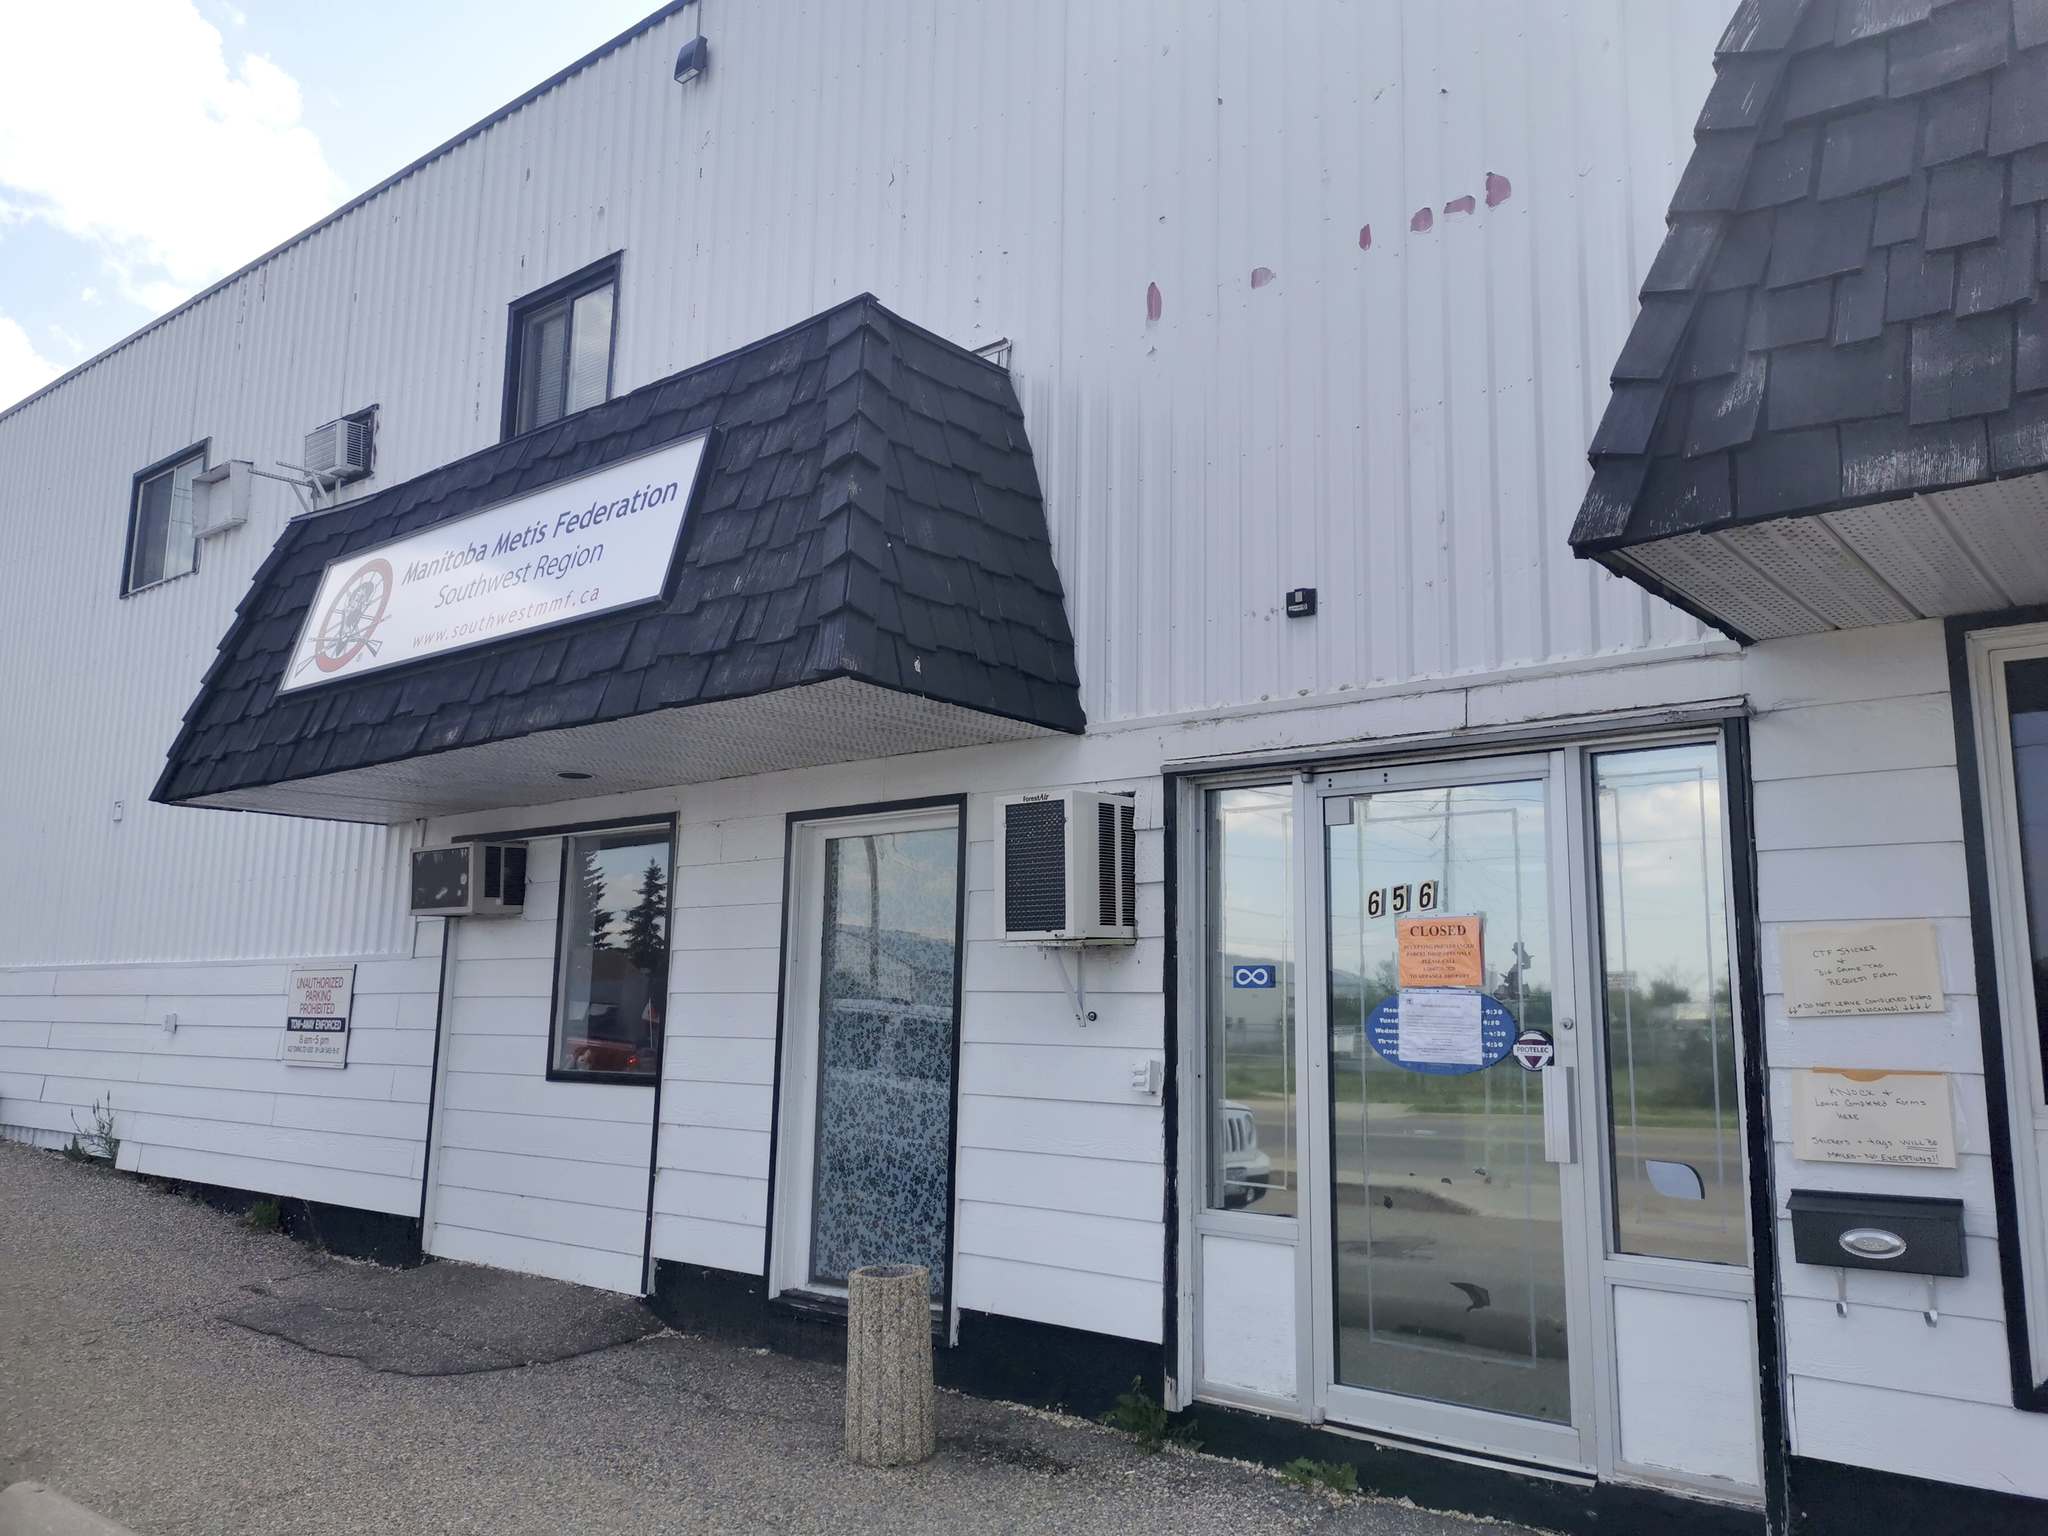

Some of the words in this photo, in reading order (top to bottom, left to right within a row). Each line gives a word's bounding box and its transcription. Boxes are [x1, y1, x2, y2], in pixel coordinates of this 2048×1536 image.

[401, 542, 488, 586] Manitoba
[491, 520, 549, 559] Metis
[553, 482, 679, 538] Federation
[434, 562, 532, 609] Southwest
[533, 543, 604, 580] Region
[412, 587, 601, 649] www.southwestmmf.ca
[1367, 882, 1433, 917] 656
[1410, 924, 1467, 937] CLOSED
[296, 976, 344, 989] UNAUTHORIZED
[305, 990, 332, 1002] PARKING
[299, 1003, 336, 1015] PROHIBITED
[315, 1019, 342, 1031] ENFORCED
